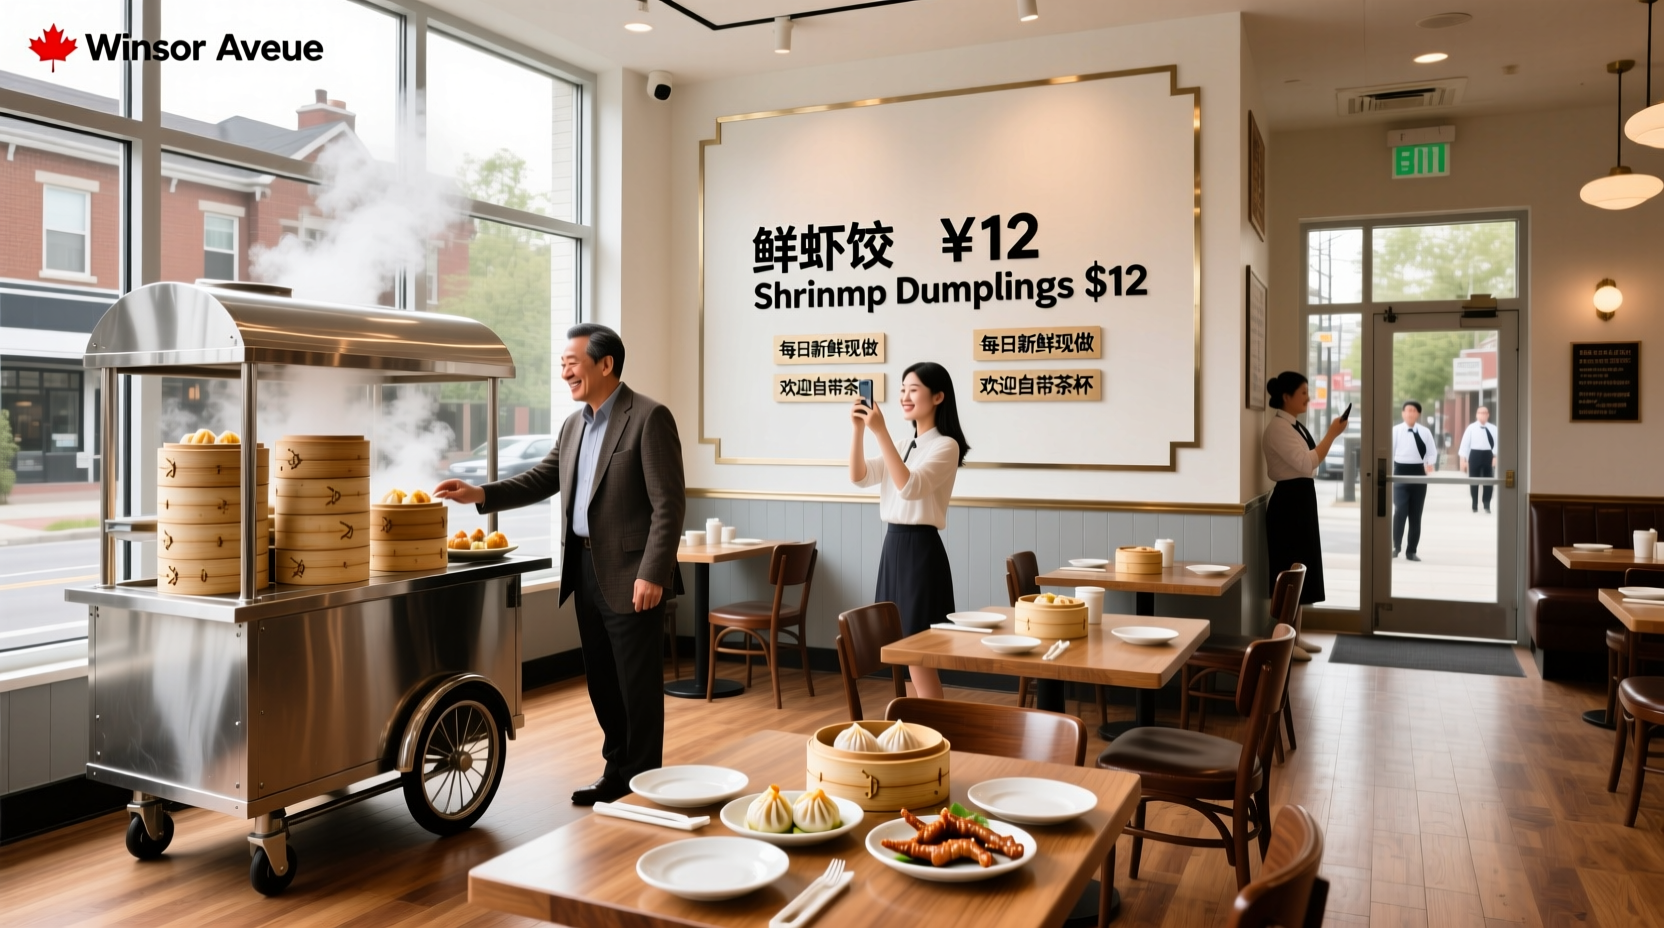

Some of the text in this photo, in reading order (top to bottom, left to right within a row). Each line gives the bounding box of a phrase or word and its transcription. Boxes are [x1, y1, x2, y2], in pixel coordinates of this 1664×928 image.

[753, 212, 1040, 274] 鲜虾饺 ¥12
[753, 260, 1149, 313] Shrinmp Dumplings $12
[779, 338, 879, 360] 每日新鲜现做
[980, 331, 1095, 355] 每日新鲜现做
[779, 376, 861, 397] 欢迎自带茶
[980, 374, 1095, 396] 欢迎自带茶杯
